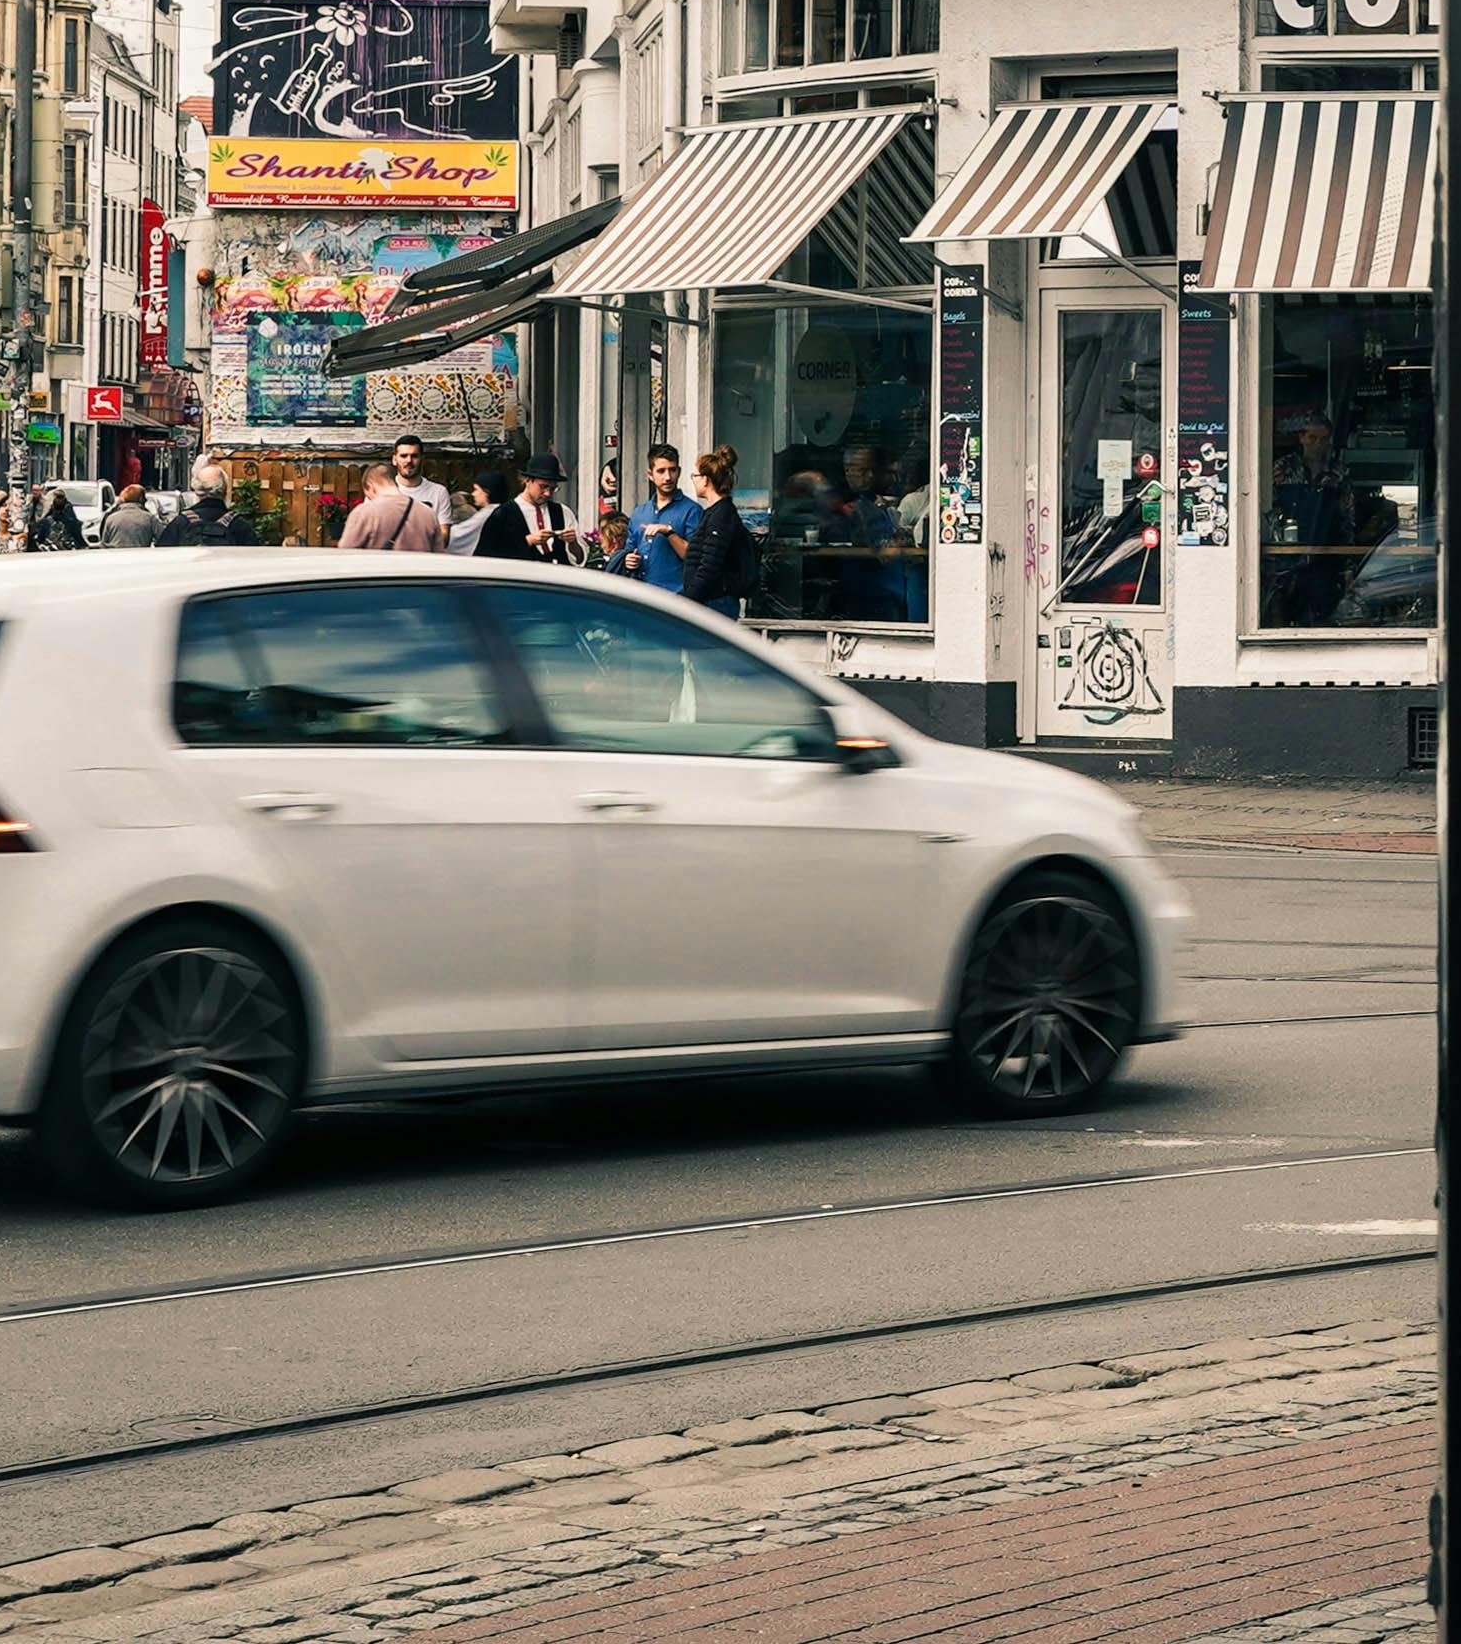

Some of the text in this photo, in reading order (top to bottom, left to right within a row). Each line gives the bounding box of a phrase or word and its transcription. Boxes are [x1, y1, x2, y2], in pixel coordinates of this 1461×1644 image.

[225, 153, 498, 189] Shanti Shop
[1181, 309, 1212, 318] Sweets
[277, 344, 327, 355] IRGEN
[797, 361, 851, 380] CORNER
